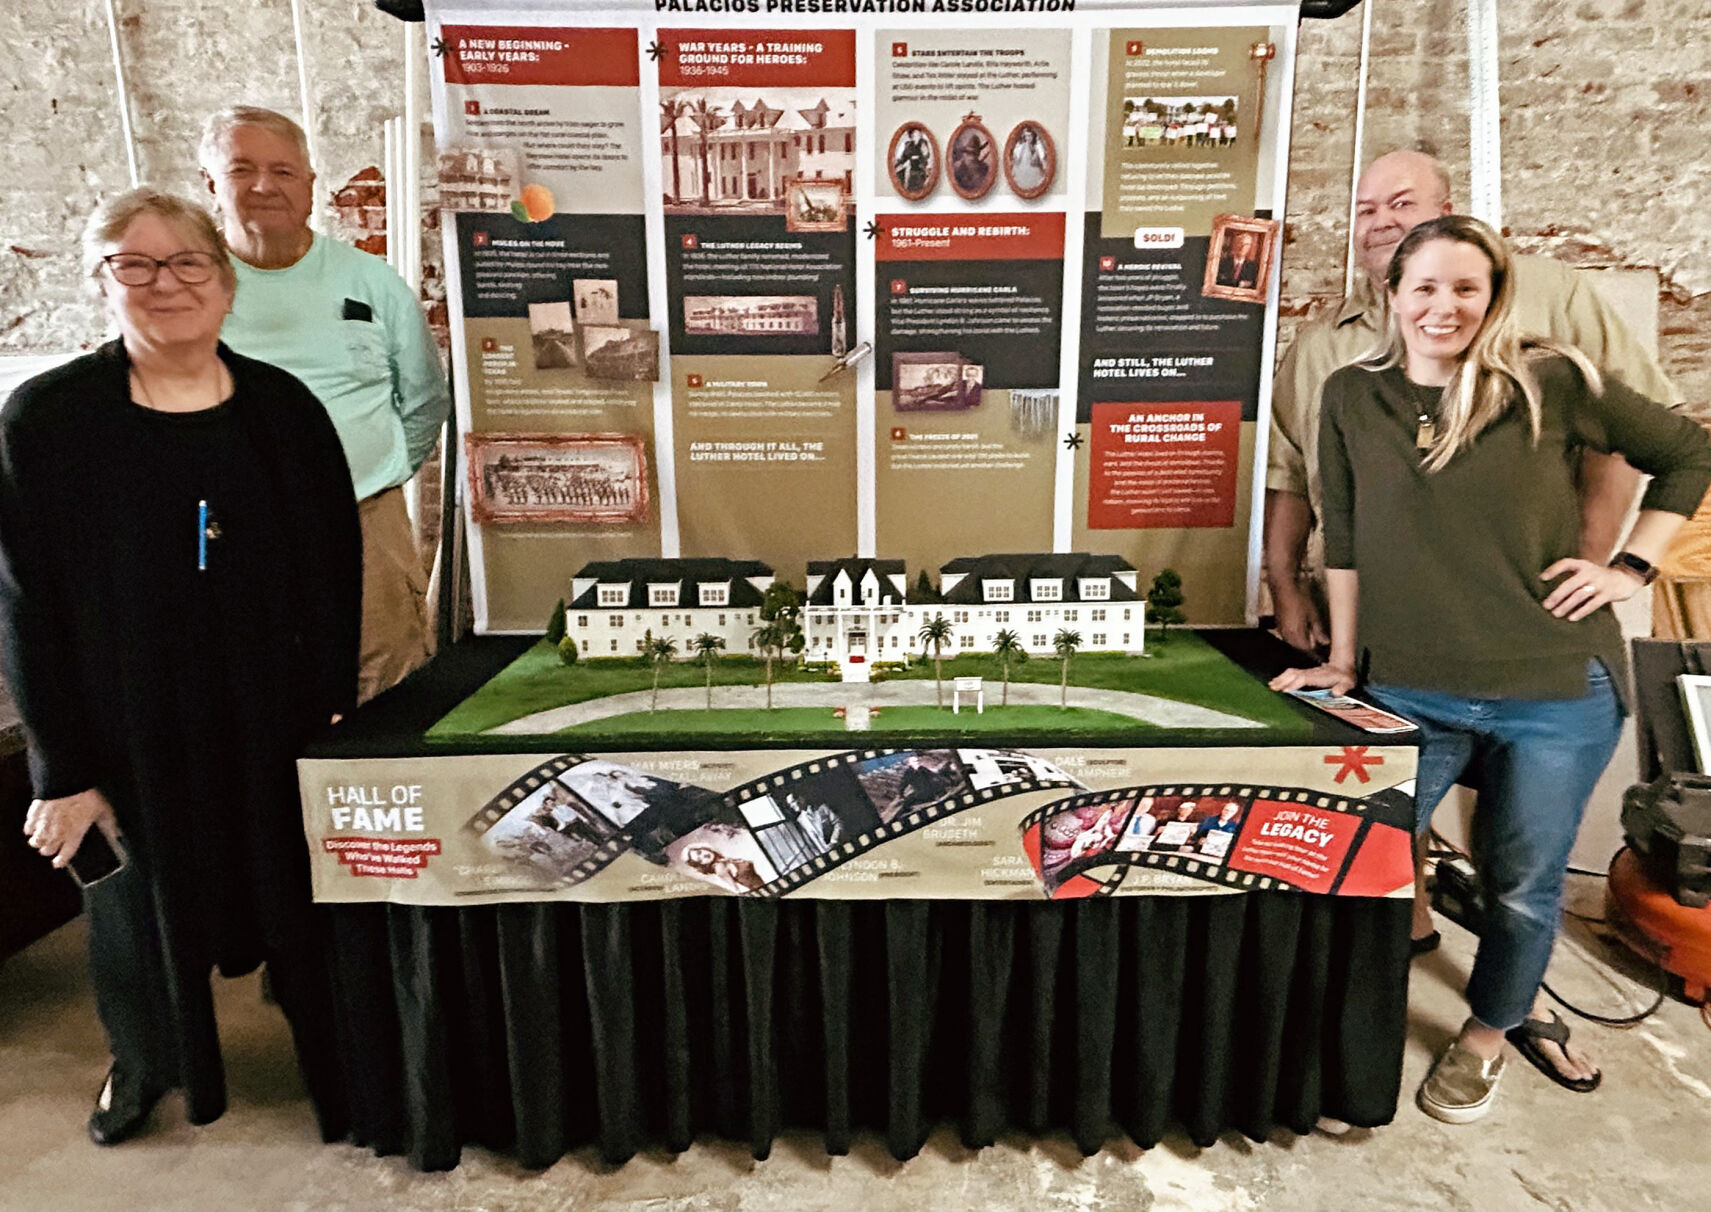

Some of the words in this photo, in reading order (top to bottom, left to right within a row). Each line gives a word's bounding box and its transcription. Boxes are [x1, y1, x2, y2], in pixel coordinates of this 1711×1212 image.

[655, 0, 760, 12] PALACIOS
[767, 0, 925, 13] PRESERVATION
[932, 0, 1075, 12] ASSOCIATION
[458, 39, 467, 49] A
[469, 39, 496, 49] NEW
[498, 40, 562, 50] BEGINNING
[679, 42, 704, 52] WAR
[707, 42, 746, 52] YEARS
[756, 42, 764, 52] A
[767, 43, 823, 54] TRAINING
[460, 50, 496, 60] EARLY
[498, 52, 540, 62] YEARS:
[679, 54, 728, 64] GROUND
[730, 54, 752, 64] FOR
[756, 54, 807, 64] HEROES:
[891, 228, 950, 237] STRUGGLE
[952, 226, 976, 237] AND
[978, 226, 1030, 237] REBIRTH:
[1143, 233, 1176, 242] SOLD!
[1094, 358, 1116, 367] AND
[1118, 358, 1150, 367] STILL,
[1152, 358, 1174, 367] THE
[1175, 357, 1214, 366] LUTHER
[1093, 368, 1128, 378] HOTEL
[1129, 368, 1160, 378] LIVES
[1128, 414, 1145, 422] AN
[1146, 414, 1191, 422] ANCHOR
[1192, 413, 1204, 422] IN
[1110, 424, 1130, 432] THE
[1133, 424, 1206, 432] CROSSROADS
[1207, 423, 1222, 432] OF
[1124, 434, 1161, 443] RURAL
[1162, 434, 1206, 443] CHANGE
[690, 442, 712, 451] AND
[714, 442, 764, 451] THROUGH
[767, 442, 778, 451] IT
[779, 442, 801, 451] ALL,
[803, 442, 824, 451] THE
[690, 452, 731, 461] LUTHER
[733, 452, 766, 461] HOTEL
[768, 452, 798, 461] LIVED
[1055, 757, 1086, 766] DALE
[328, 786, 387, 805] HALL
[391, 785, 422, 805] OF
[331, 806, 425, 832] FAME
[962, 818, 982, 827] JIM
[1273, 811, 1300, 821] JOIN
[1302, 814, 1330, 829] THE
[1260, 822, 1334, 848] LEGACY
[372, 842, 390, 851] the
[390, 842, 438, 854] Legends
[992, 857, 1023, 866] SARA
